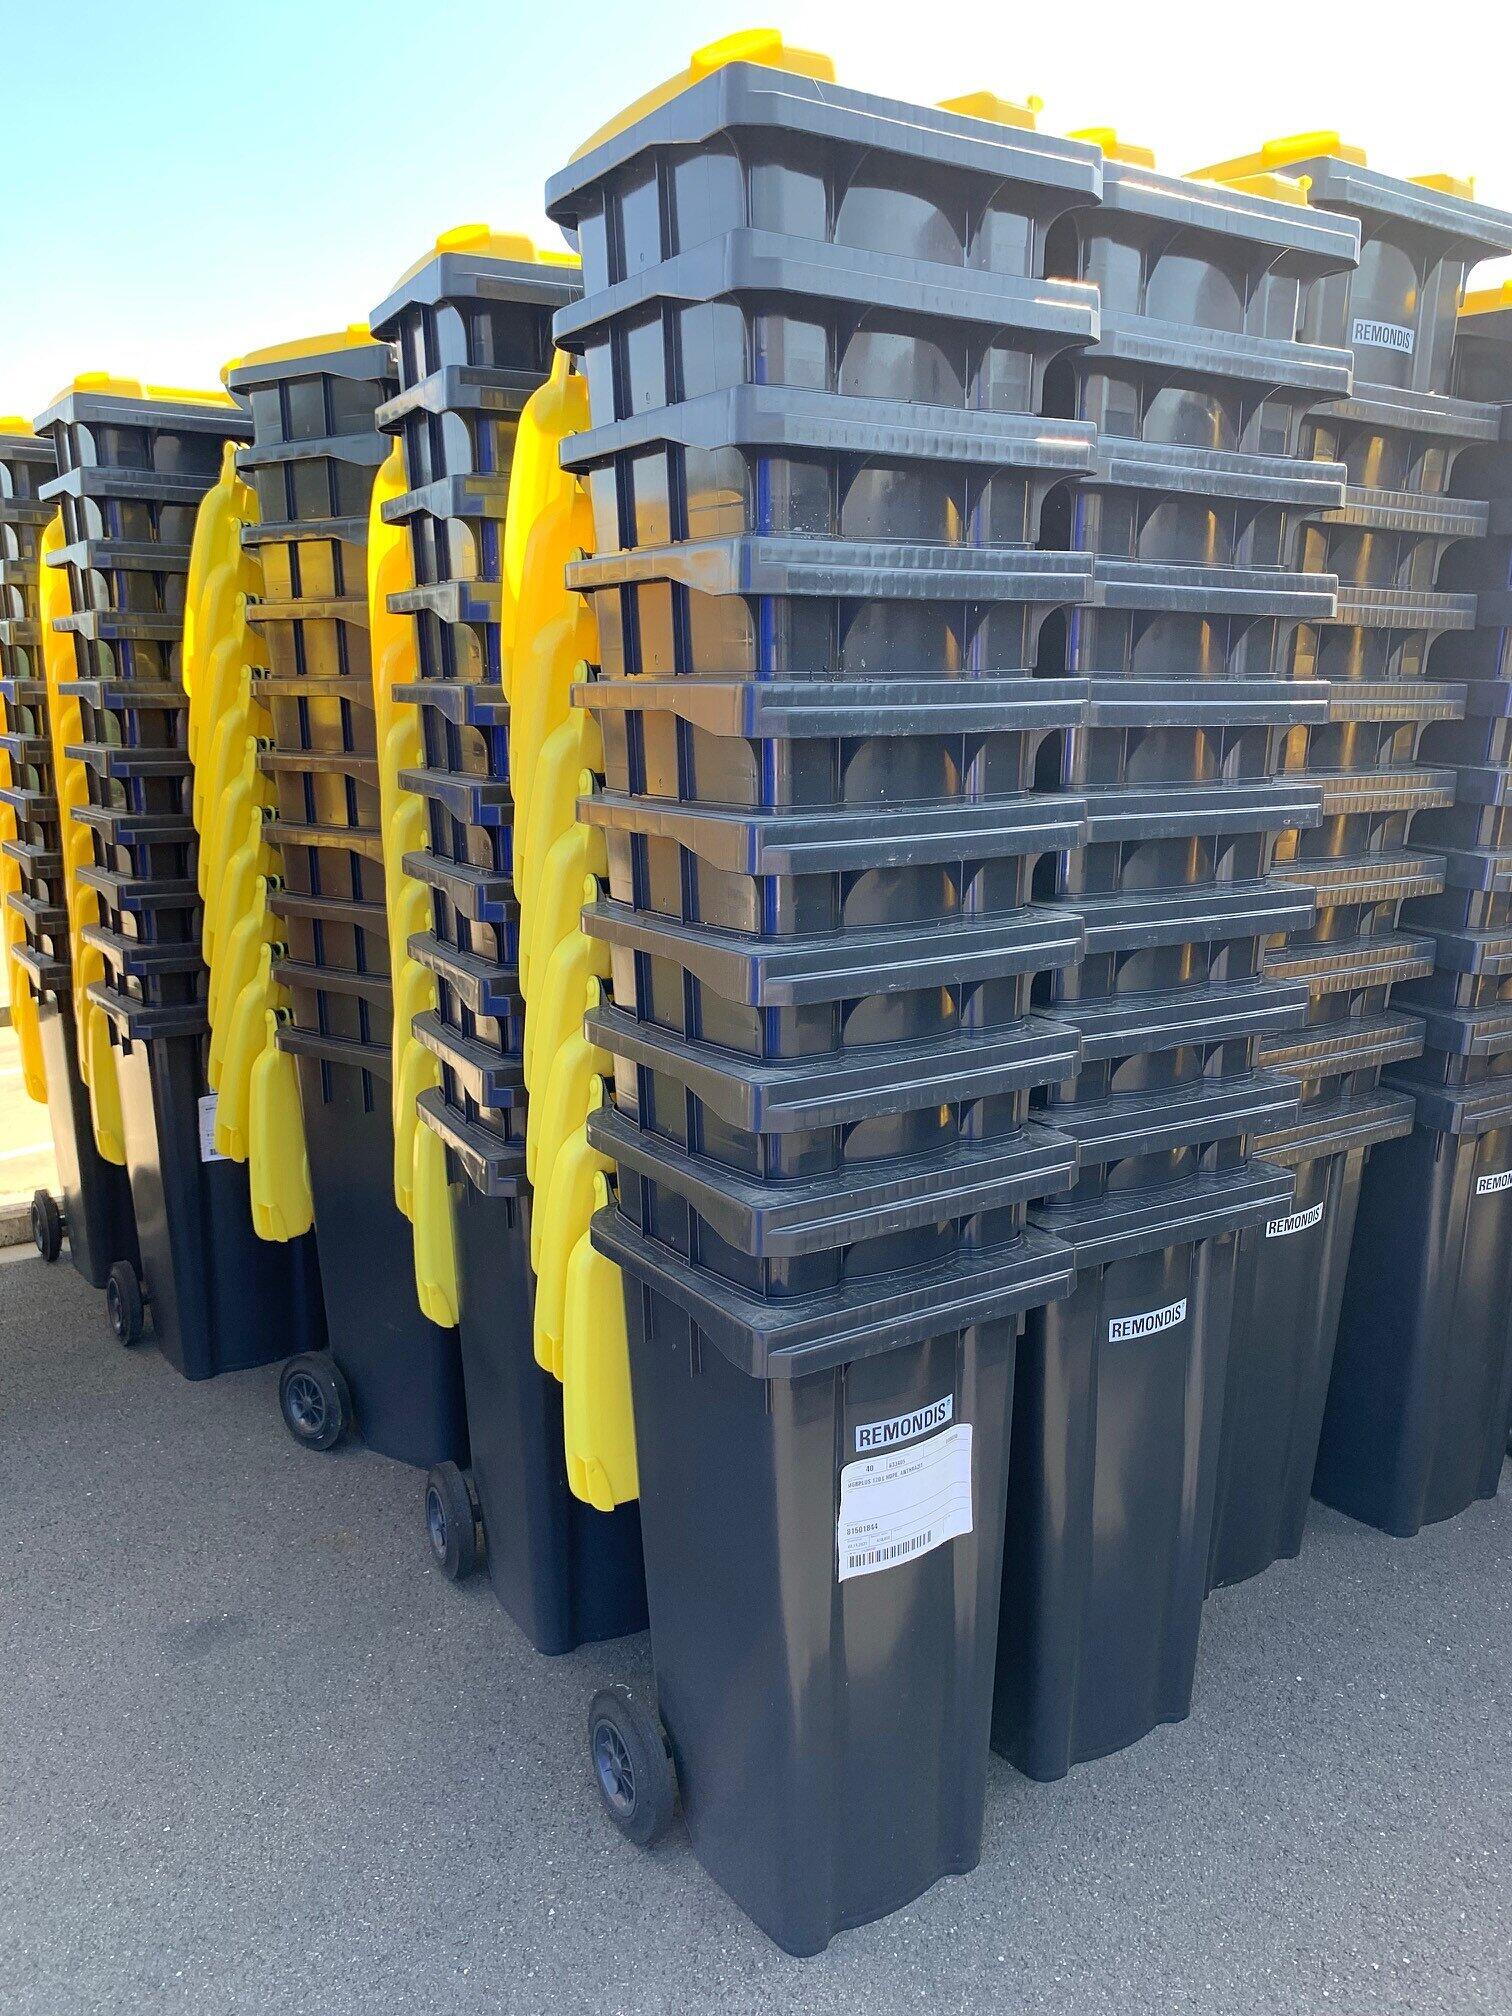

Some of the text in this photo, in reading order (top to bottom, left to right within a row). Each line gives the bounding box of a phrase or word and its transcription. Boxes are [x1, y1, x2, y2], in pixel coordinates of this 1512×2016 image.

[1354, 322, 1411, 349] REMONDIS
[1268, 1206, 1320, 1235] REMONDIS
[1112, 1304, 1182, 1338] REMONDIS
[859, 1401, 947, 1447] REMONDIS
[846, 1522, 878, 1536] 81501844
